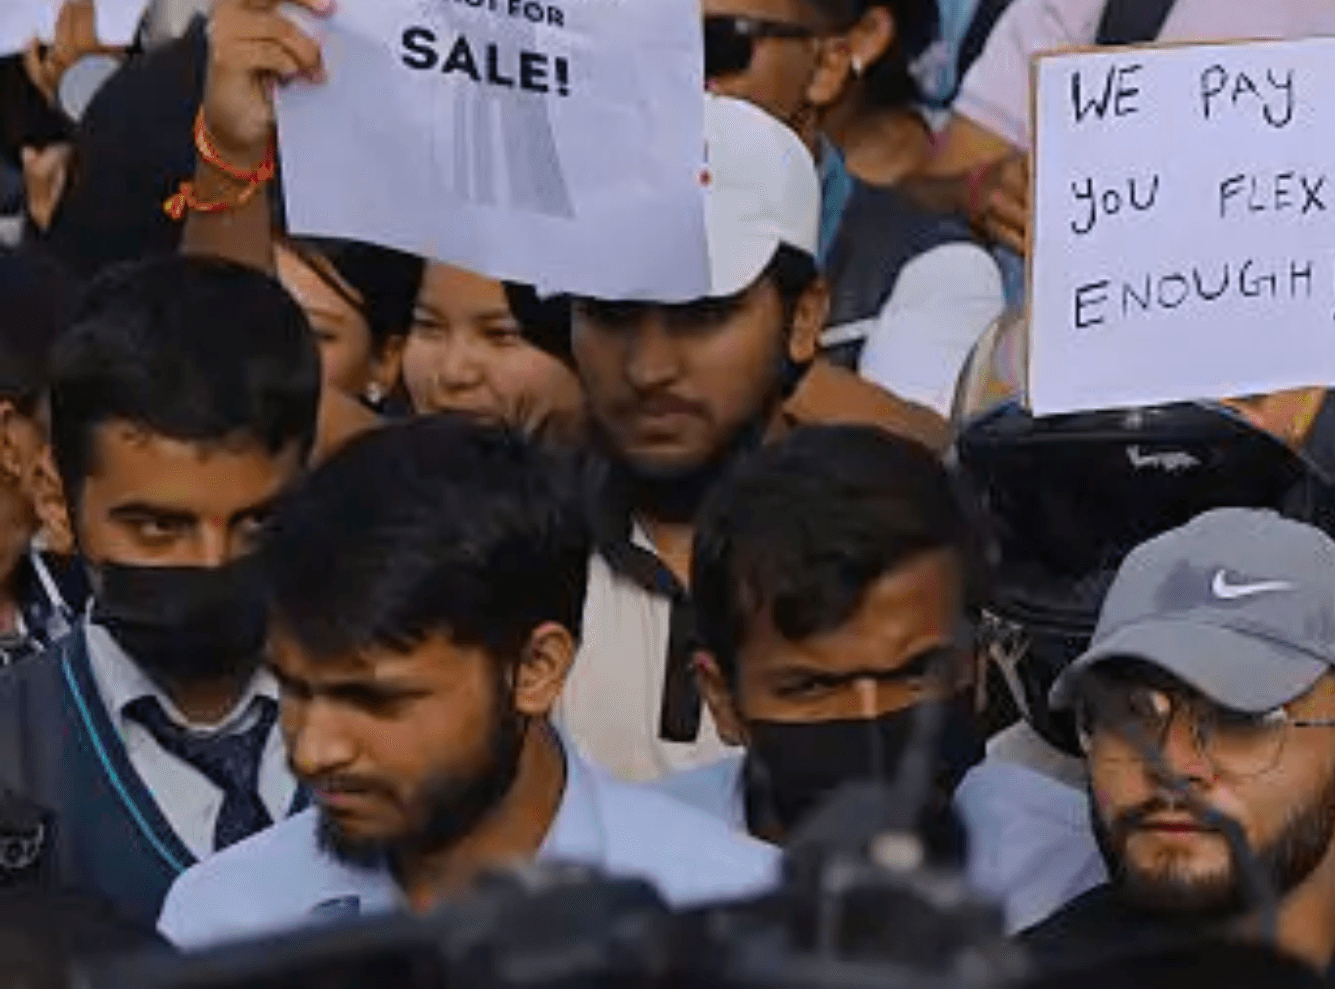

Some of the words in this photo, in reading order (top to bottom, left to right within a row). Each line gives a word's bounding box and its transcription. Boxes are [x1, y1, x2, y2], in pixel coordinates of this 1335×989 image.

[402, 25, 571, 97] SALE!
[1070, 63, 1143, 123] WE
[1219, 172, 1328, 218] FLEX
